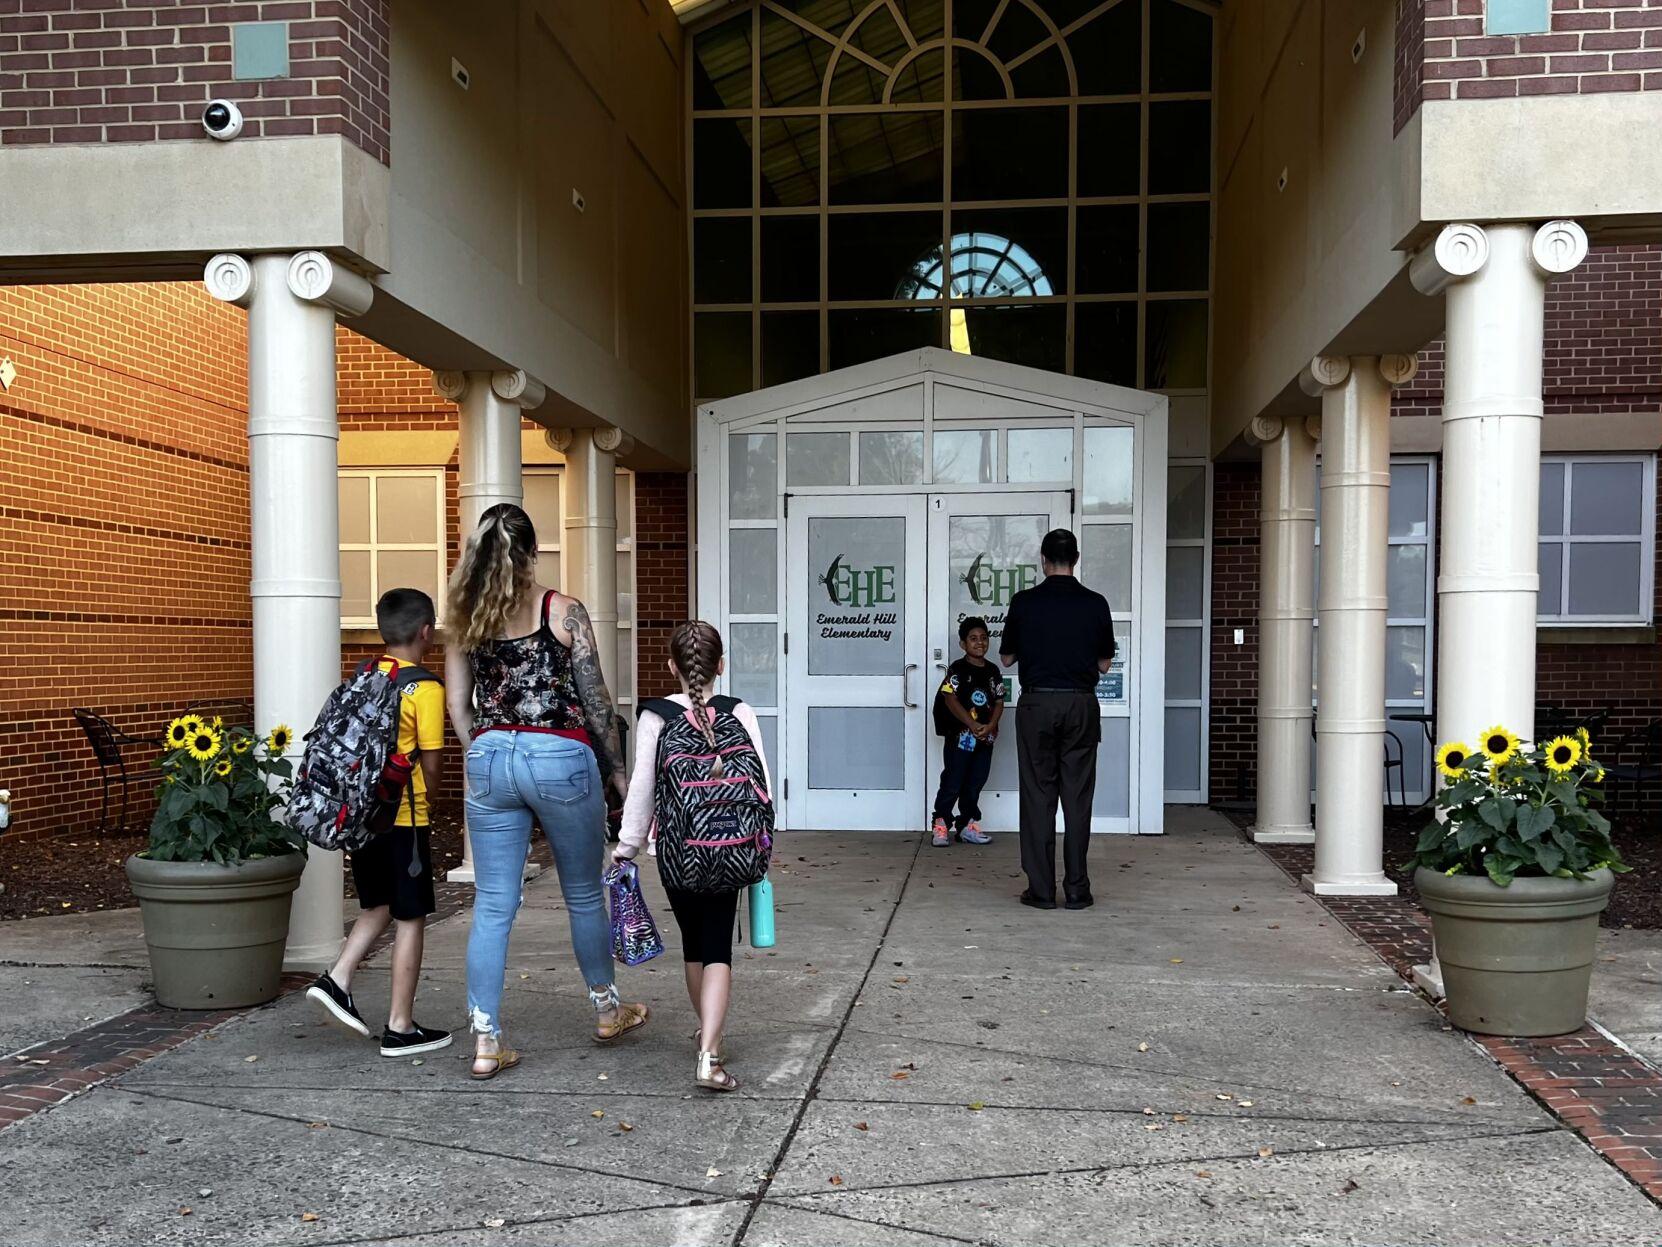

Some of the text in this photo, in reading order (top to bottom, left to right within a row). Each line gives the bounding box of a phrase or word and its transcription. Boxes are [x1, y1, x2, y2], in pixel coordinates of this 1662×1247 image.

[935, 499, 941, 509] 1
[834, 565, 896, 607] EHE
[816, 613, 897, 625] Emerald Hill
[821, 627, 892, 641] Elementary
